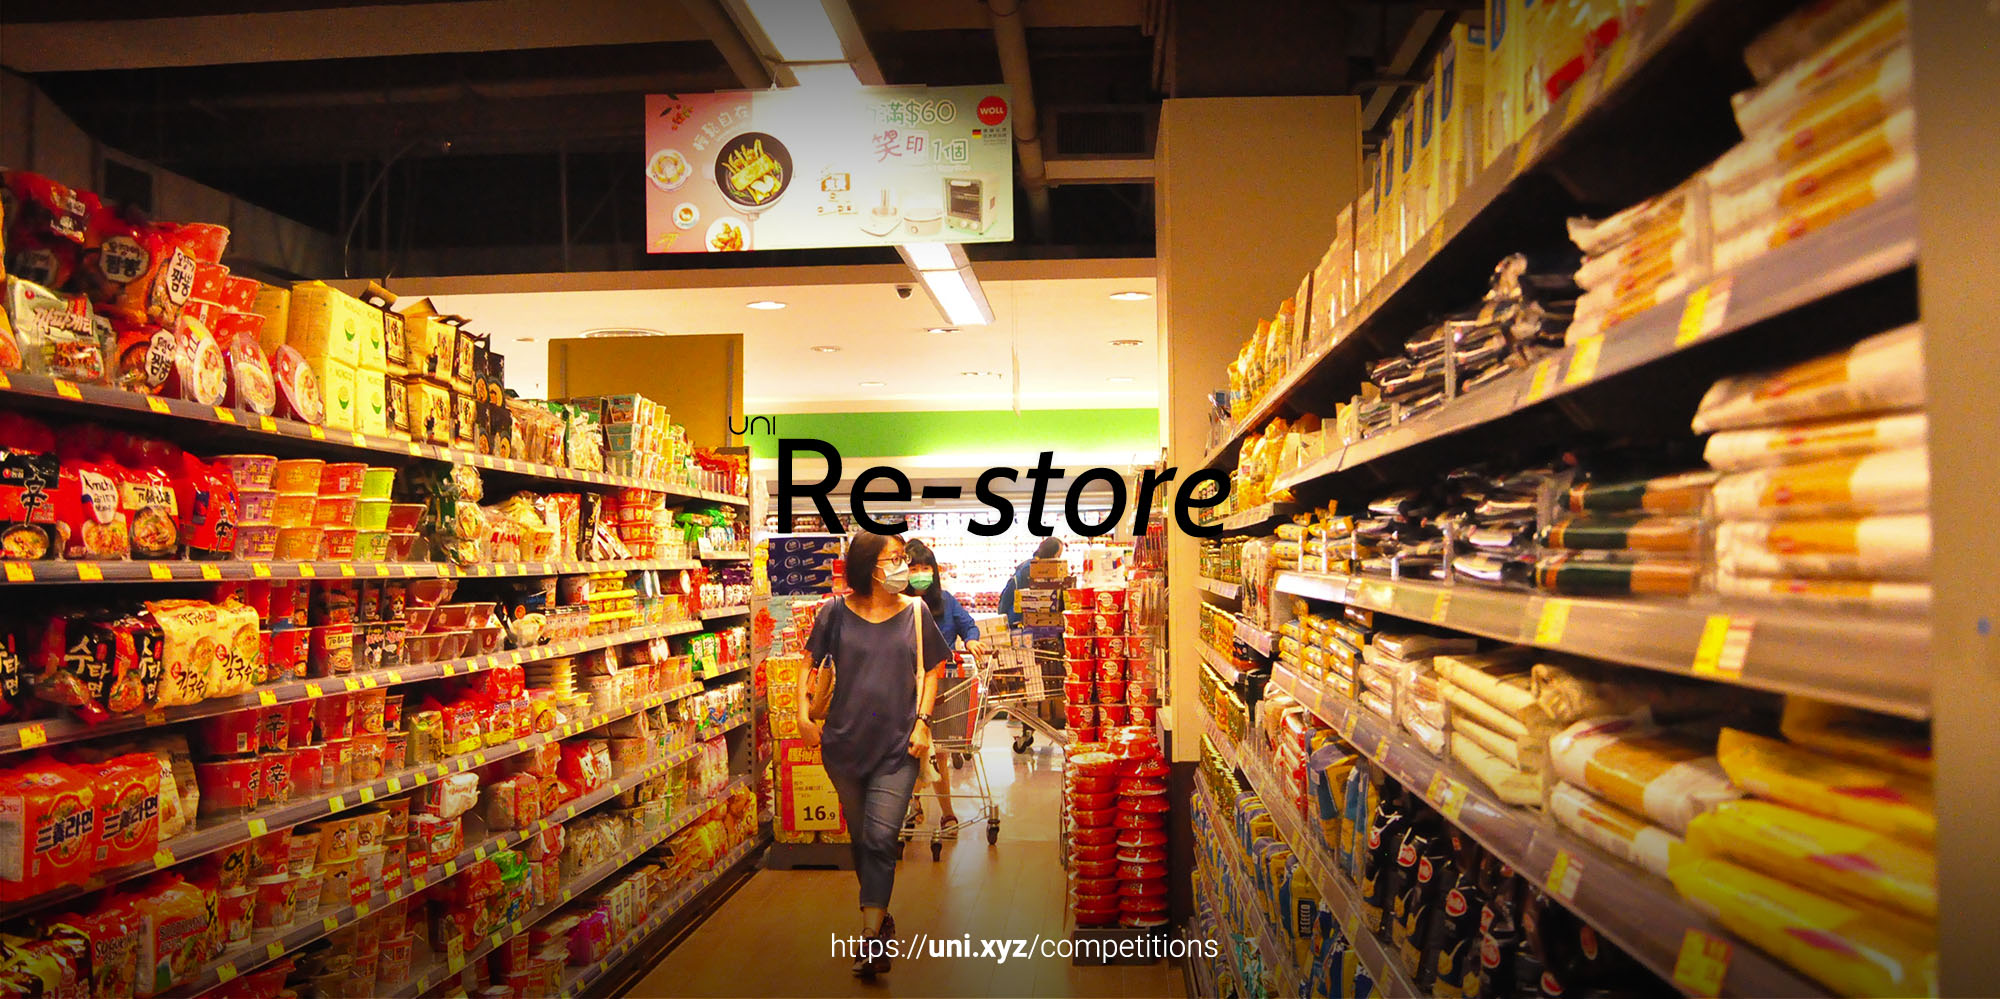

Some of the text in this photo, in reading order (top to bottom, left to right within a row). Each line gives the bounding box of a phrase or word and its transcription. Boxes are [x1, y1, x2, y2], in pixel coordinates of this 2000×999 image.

[979, 107, 1004, 115] WOLL
[64, 635, 111, 698] 수타면
[803, 805, 836, 821] 16.9
